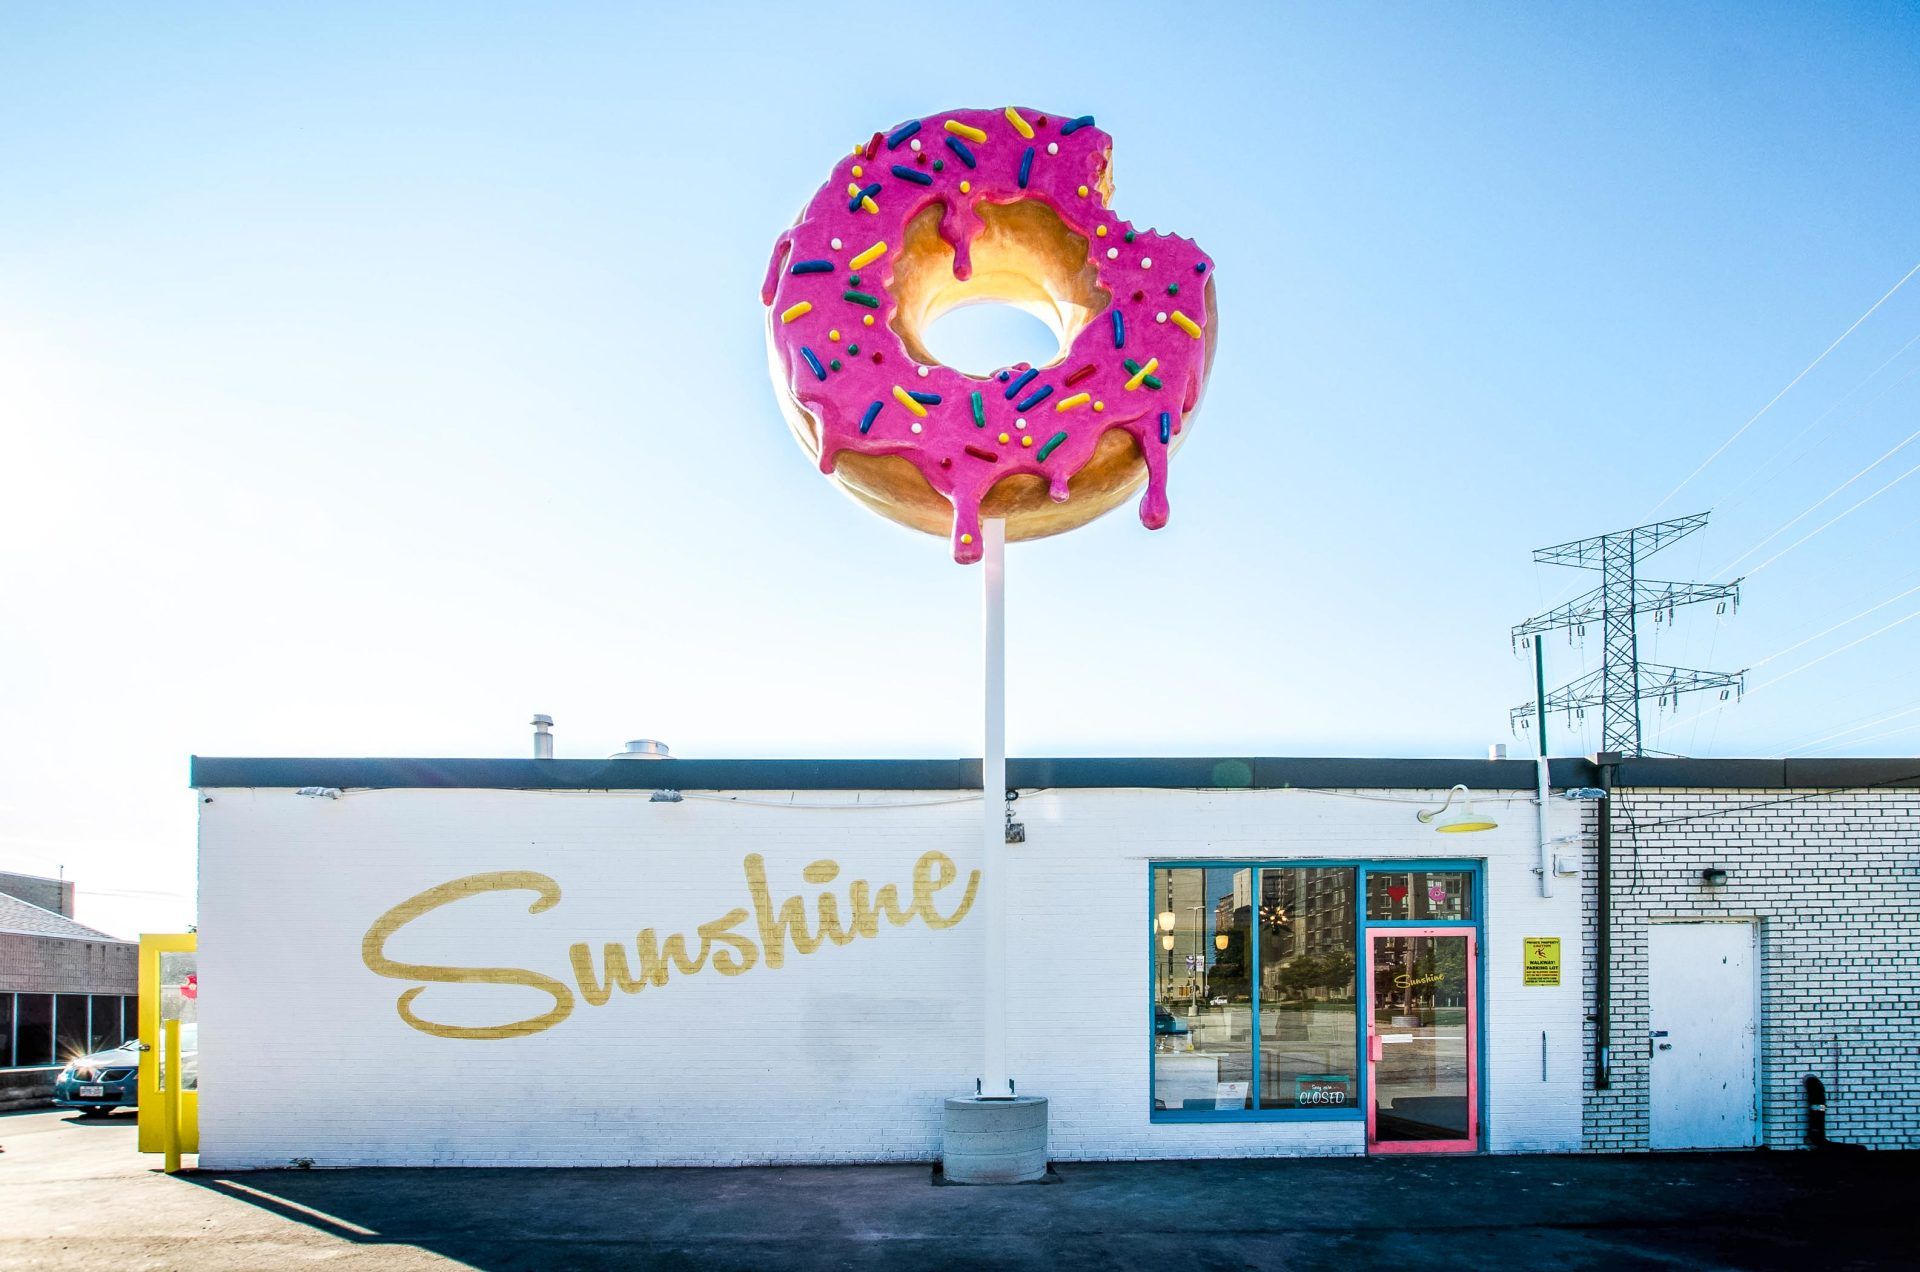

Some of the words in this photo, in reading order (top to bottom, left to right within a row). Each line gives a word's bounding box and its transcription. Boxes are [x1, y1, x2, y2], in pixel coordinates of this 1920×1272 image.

[362, 850, 981, 1040] Sunshine
[1394, 973, 1445, 988] Sunshine
[1299, 1091, 1345, 1105] CLOSED
